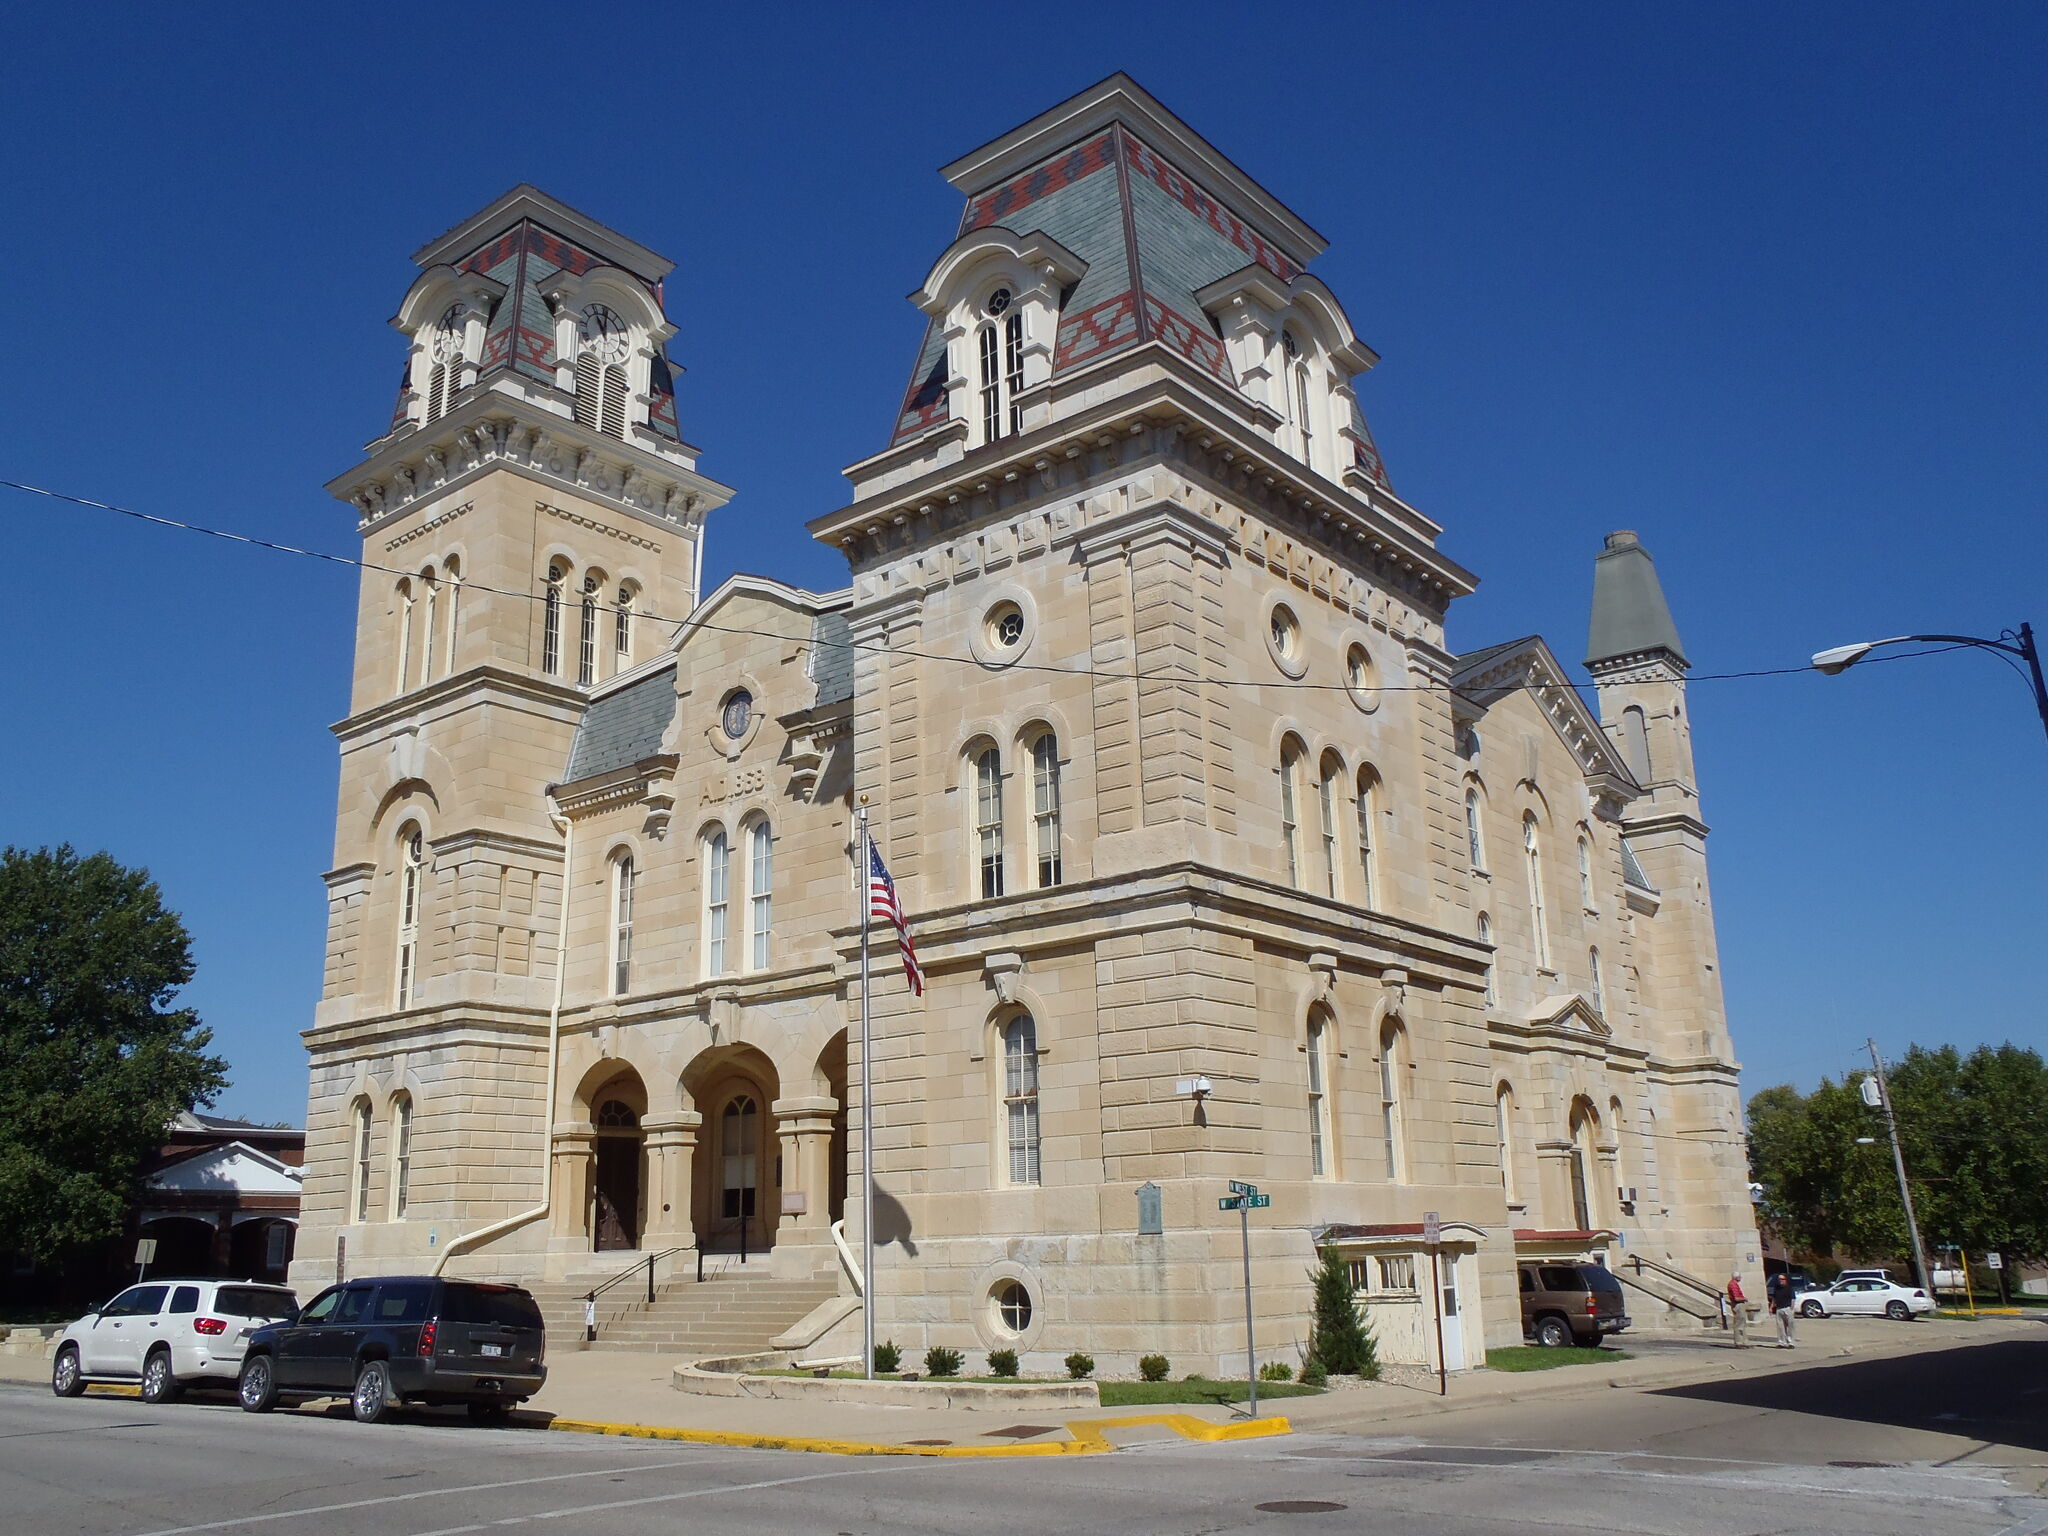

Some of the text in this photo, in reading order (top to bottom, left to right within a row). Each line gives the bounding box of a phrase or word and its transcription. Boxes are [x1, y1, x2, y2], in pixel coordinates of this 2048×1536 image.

[1230, 1182, 1256, 1195] N WEST ST
[1220, 1196, 1266, 1208] W STATE ST
